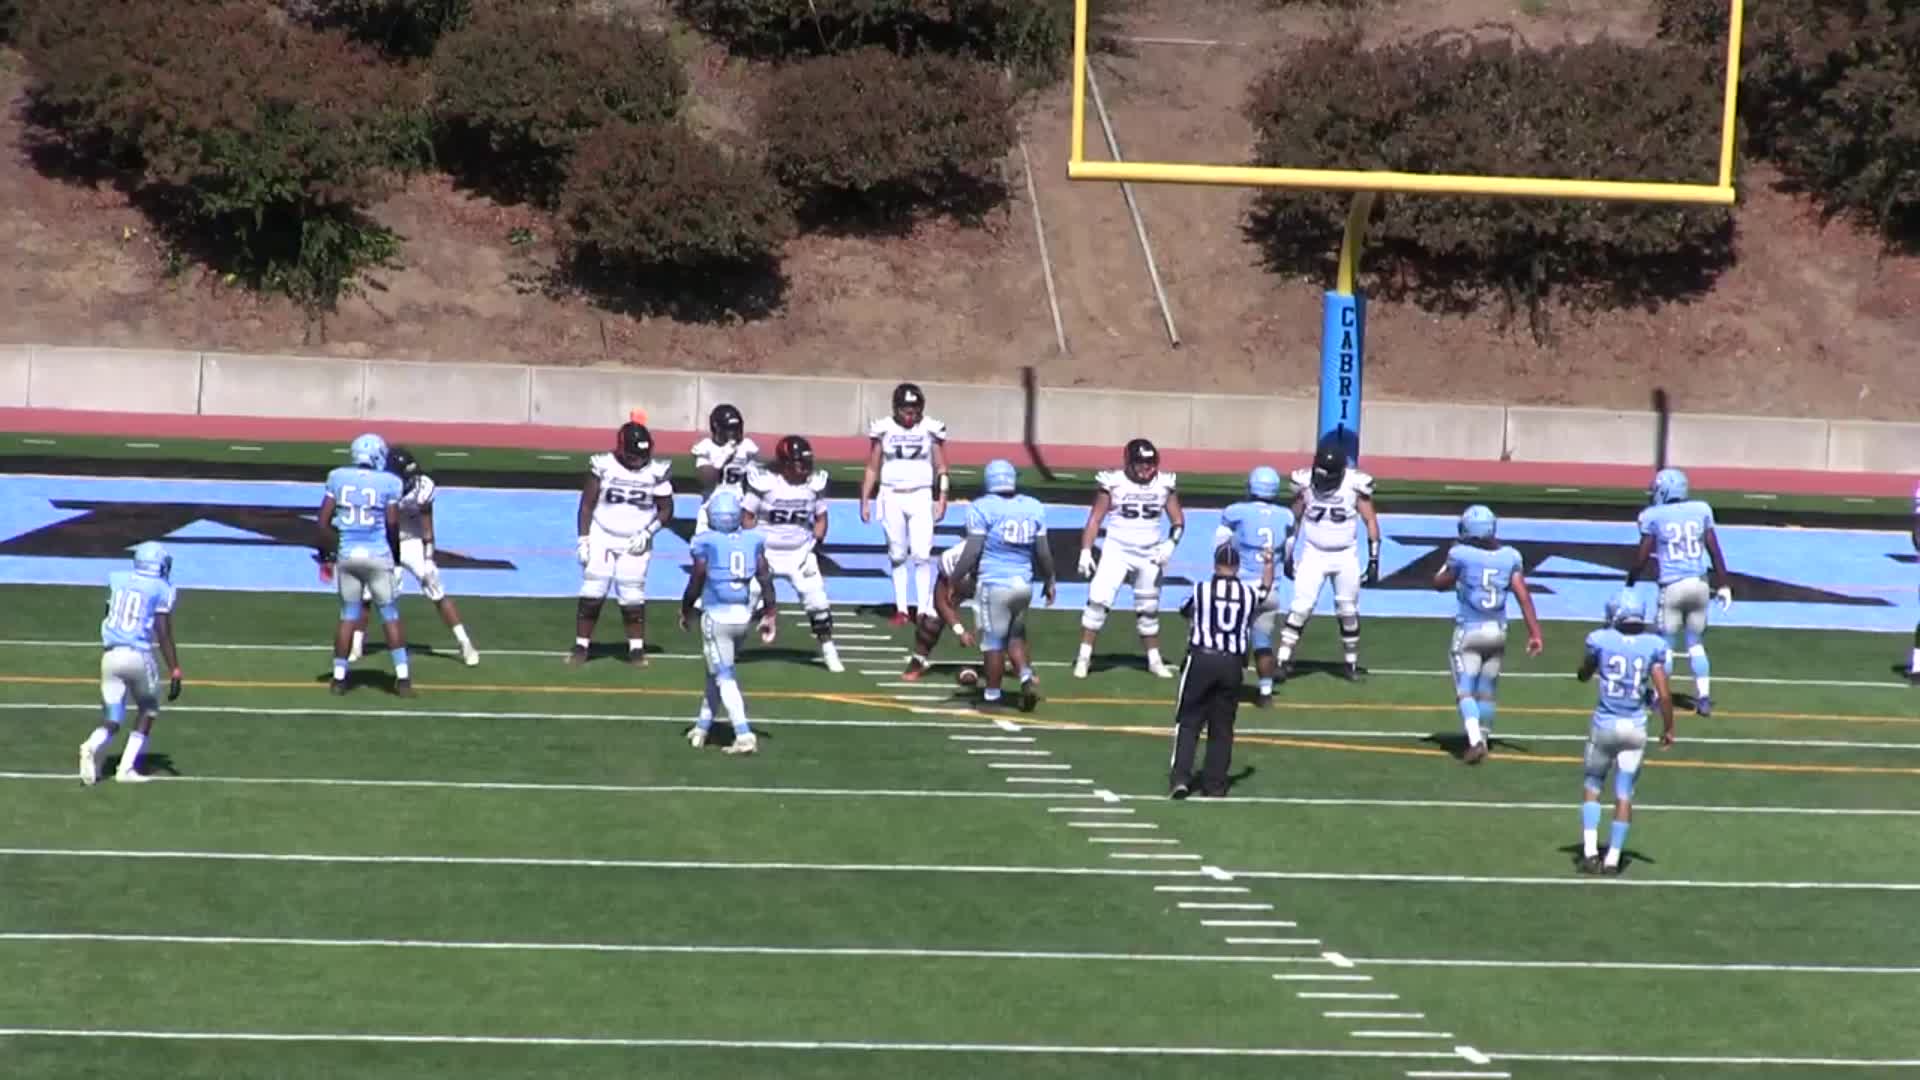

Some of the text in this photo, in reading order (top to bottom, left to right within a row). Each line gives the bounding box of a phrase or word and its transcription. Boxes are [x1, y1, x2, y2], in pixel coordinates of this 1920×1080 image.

[892, 444, 924, 460] 17
[340, 485, 376, 526] 52
[605, 487, 651, 505] 62
[1121, 502, 1162, 520] 55
[1310, 505, 1347, 523] 75
[1481, 568, 1499, 609] 5
[107, 588, 142, 633] 10
[1214, 600, 1241, 632] U
[1607, 655, 1641, 700] 21
